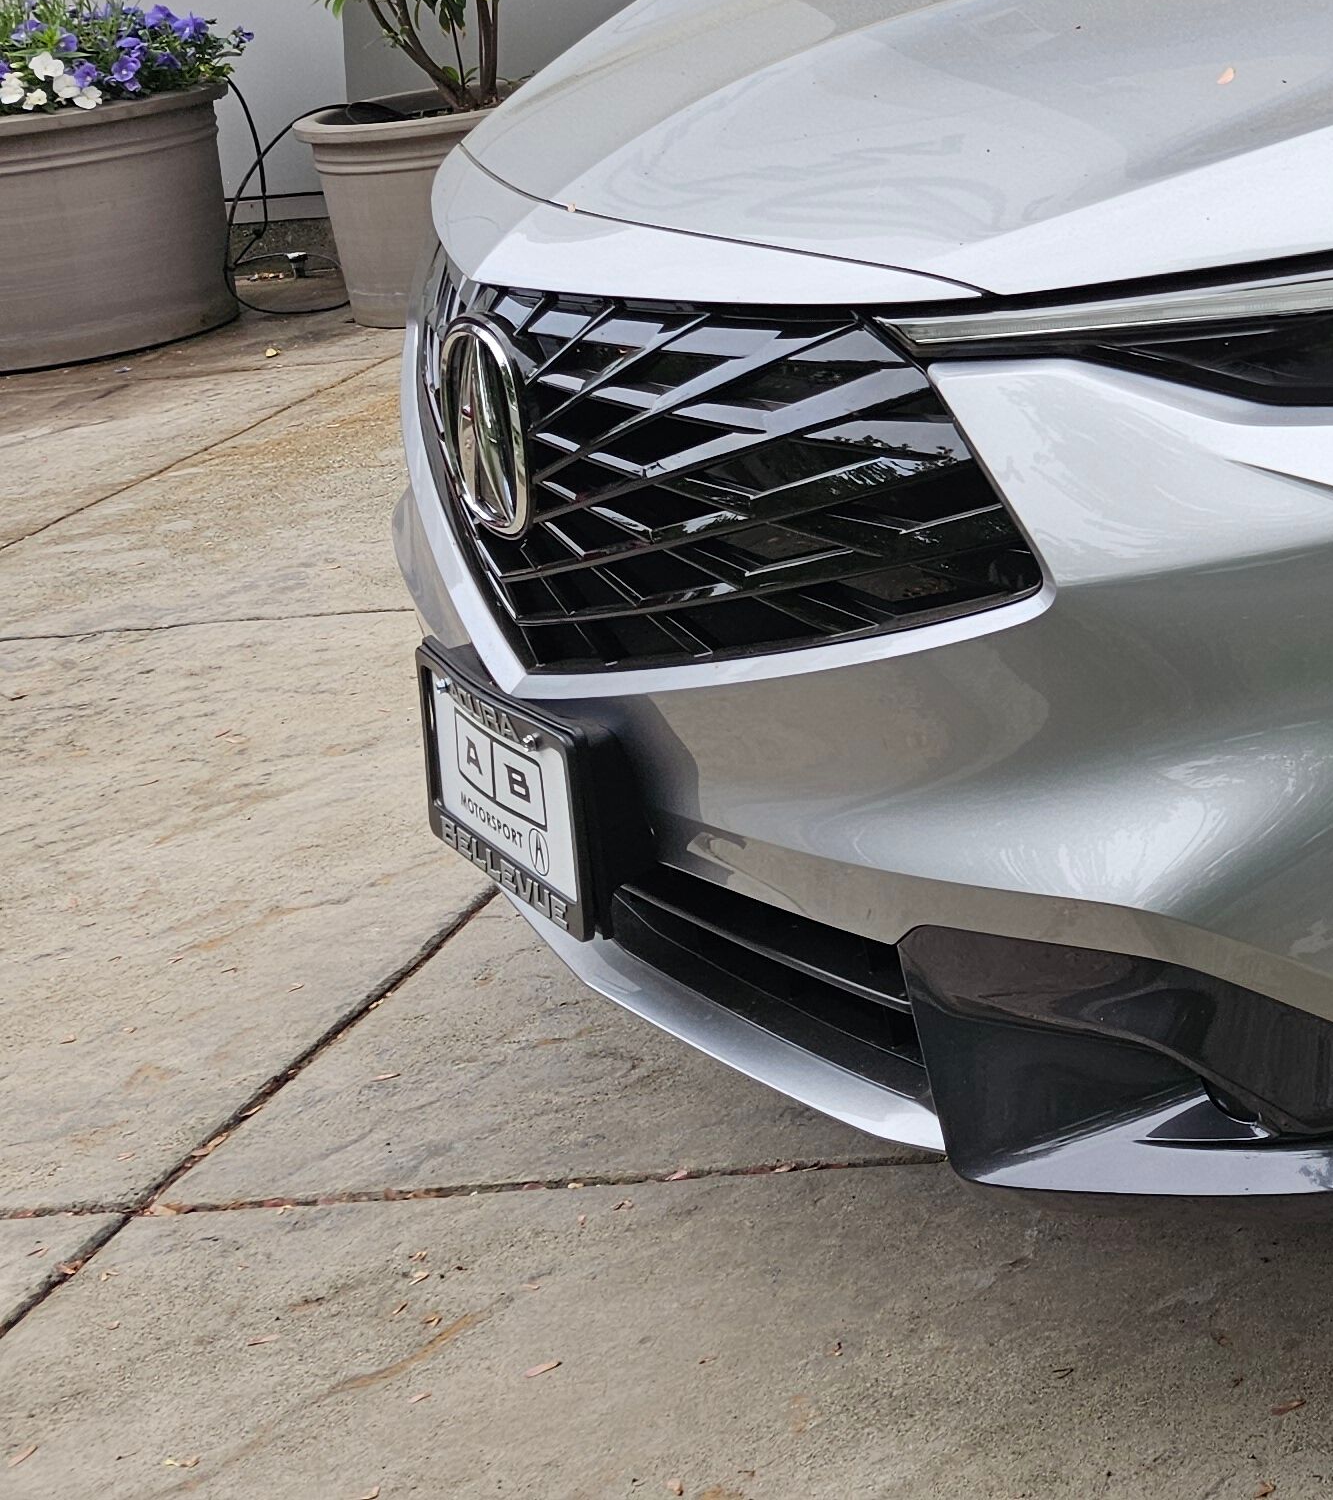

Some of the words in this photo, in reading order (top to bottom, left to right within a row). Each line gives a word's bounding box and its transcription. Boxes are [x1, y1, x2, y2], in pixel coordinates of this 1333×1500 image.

[448, 682, 521, 744] ACURA
[465, 735, 484, 776] A
[504, 763, 532, 804] B
[460, 791, 523, 849] MOTORSPORT
[440, 815, 569, 931] BELLEVUE
